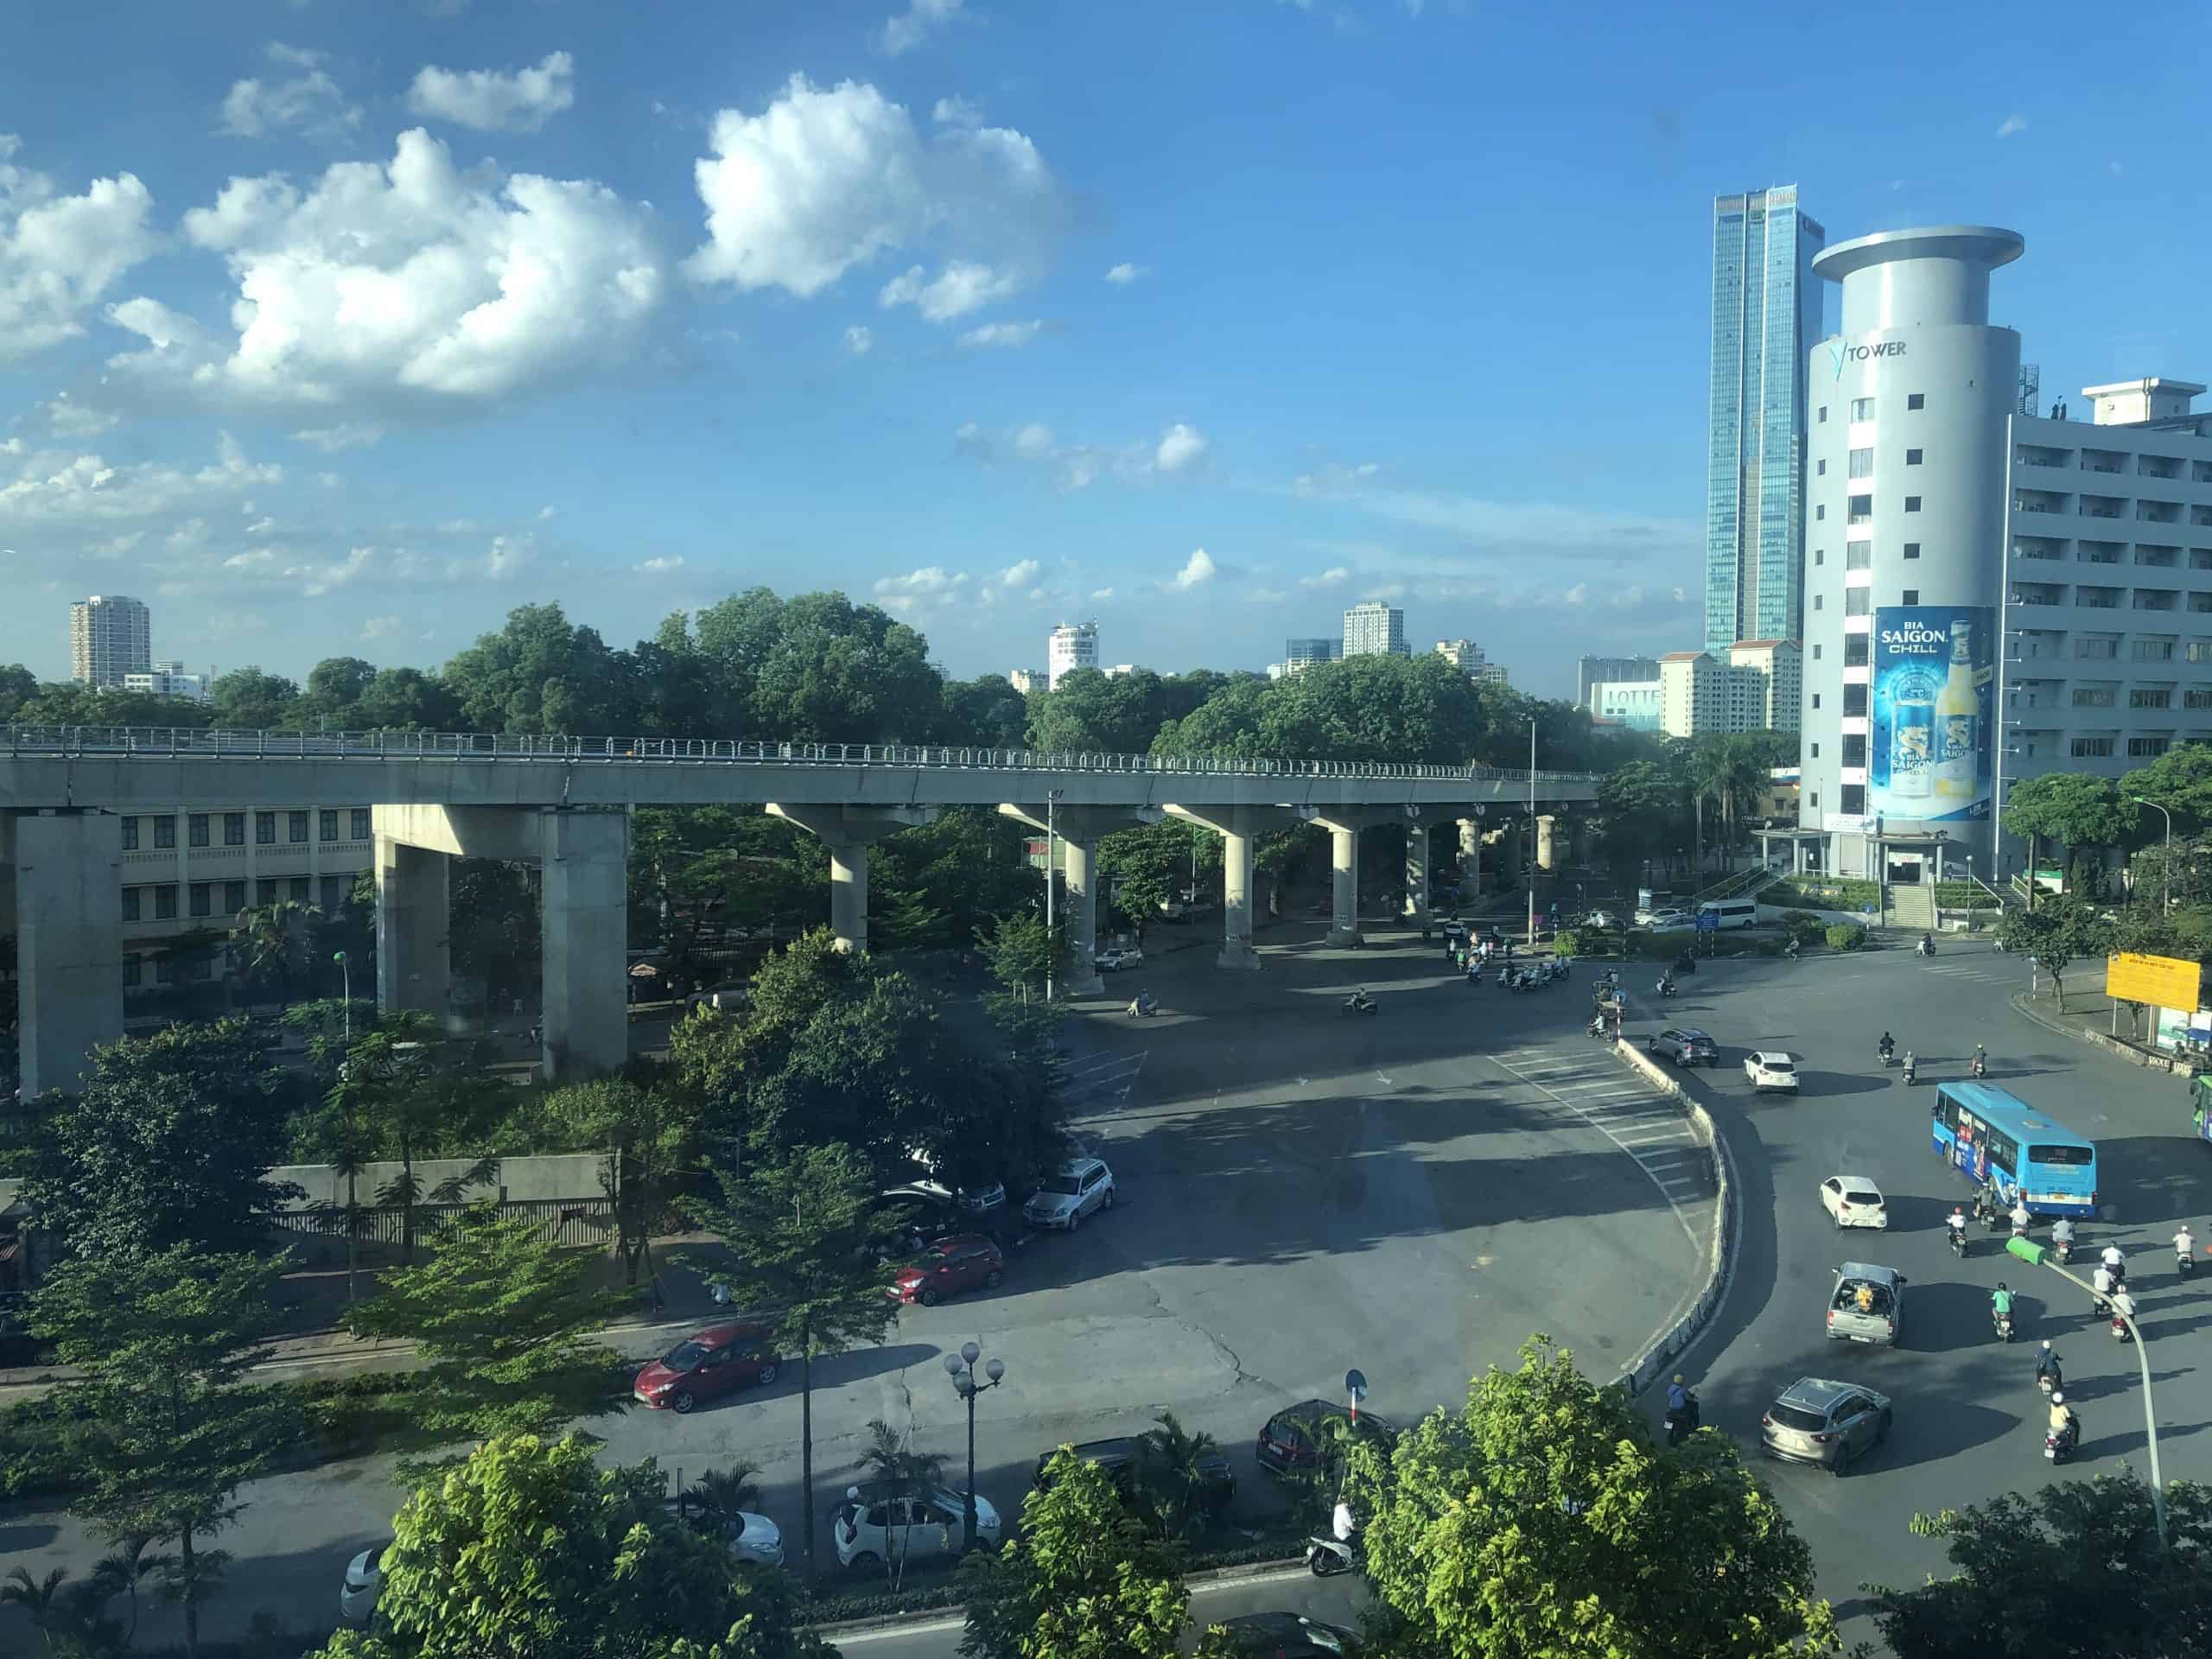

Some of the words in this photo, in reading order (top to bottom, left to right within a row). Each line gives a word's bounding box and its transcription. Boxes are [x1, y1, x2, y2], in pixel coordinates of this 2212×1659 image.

[1847, 341, 1907, 361] TOWER
[1904, 621, 1924, 630] BIA
[1889, 645, 1937, 653] CHILL
[1609, 690, 1660, 705] LOTTE
